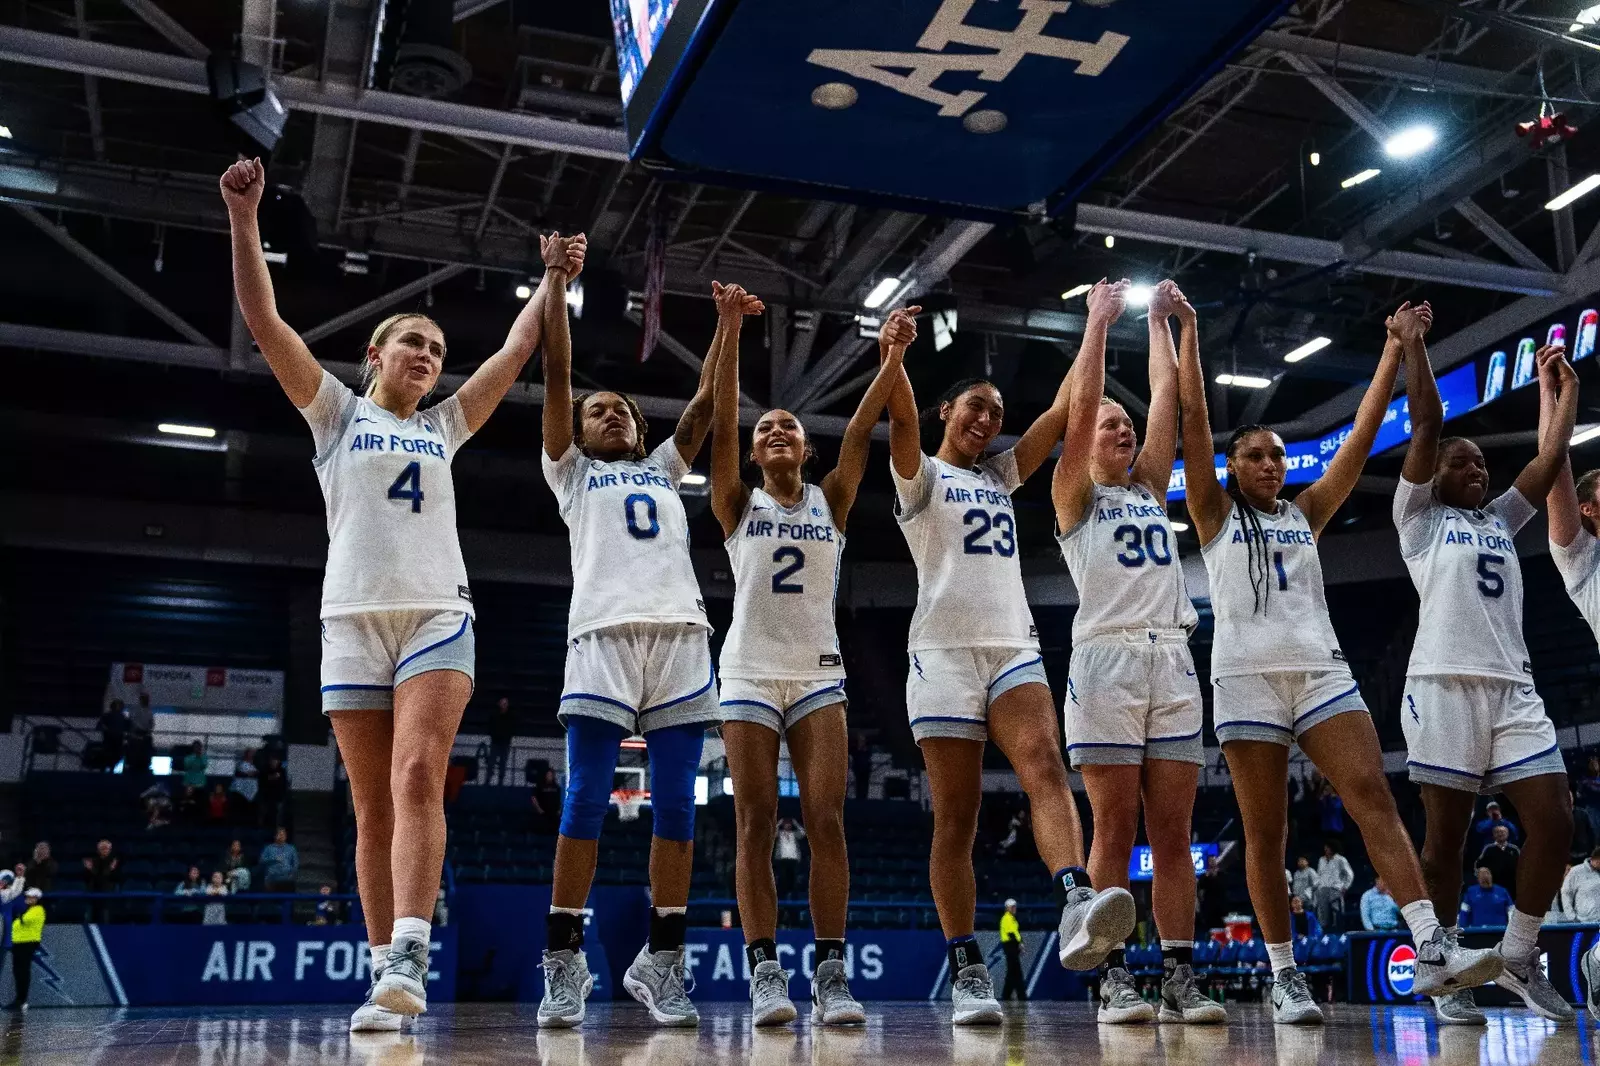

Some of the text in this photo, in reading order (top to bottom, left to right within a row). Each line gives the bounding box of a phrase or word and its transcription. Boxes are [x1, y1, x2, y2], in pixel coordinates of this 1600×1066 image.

[350, 433, 446, 460] AIR FORCE
[387, 460, 425, 514] 4
[587, 473, 618, 491] AIR
[945, 487, 972, 503] AIR
[623, 492, 660, 540] 0
[1097, 507, 1123, 523] AIR
[746, 520, 834, 543] AIR FORCE
[963, 508, 1015, 558] 23
[1264, 528, 1313, 546] FORCE
[1445, 531, 1474, 546] AIR
[1113, 523, 1173, 568] 30
[771, 545, 806, 594] 2
[1273, 551, 1288, 592] 1
[1476, 552, 1505, 599] 5
[148, 669, 272, 685] TOYOTA TOYOTA
[201, 940, 442, 982] AIR FORE
[1390, 964, 1415, 975] PEPS
